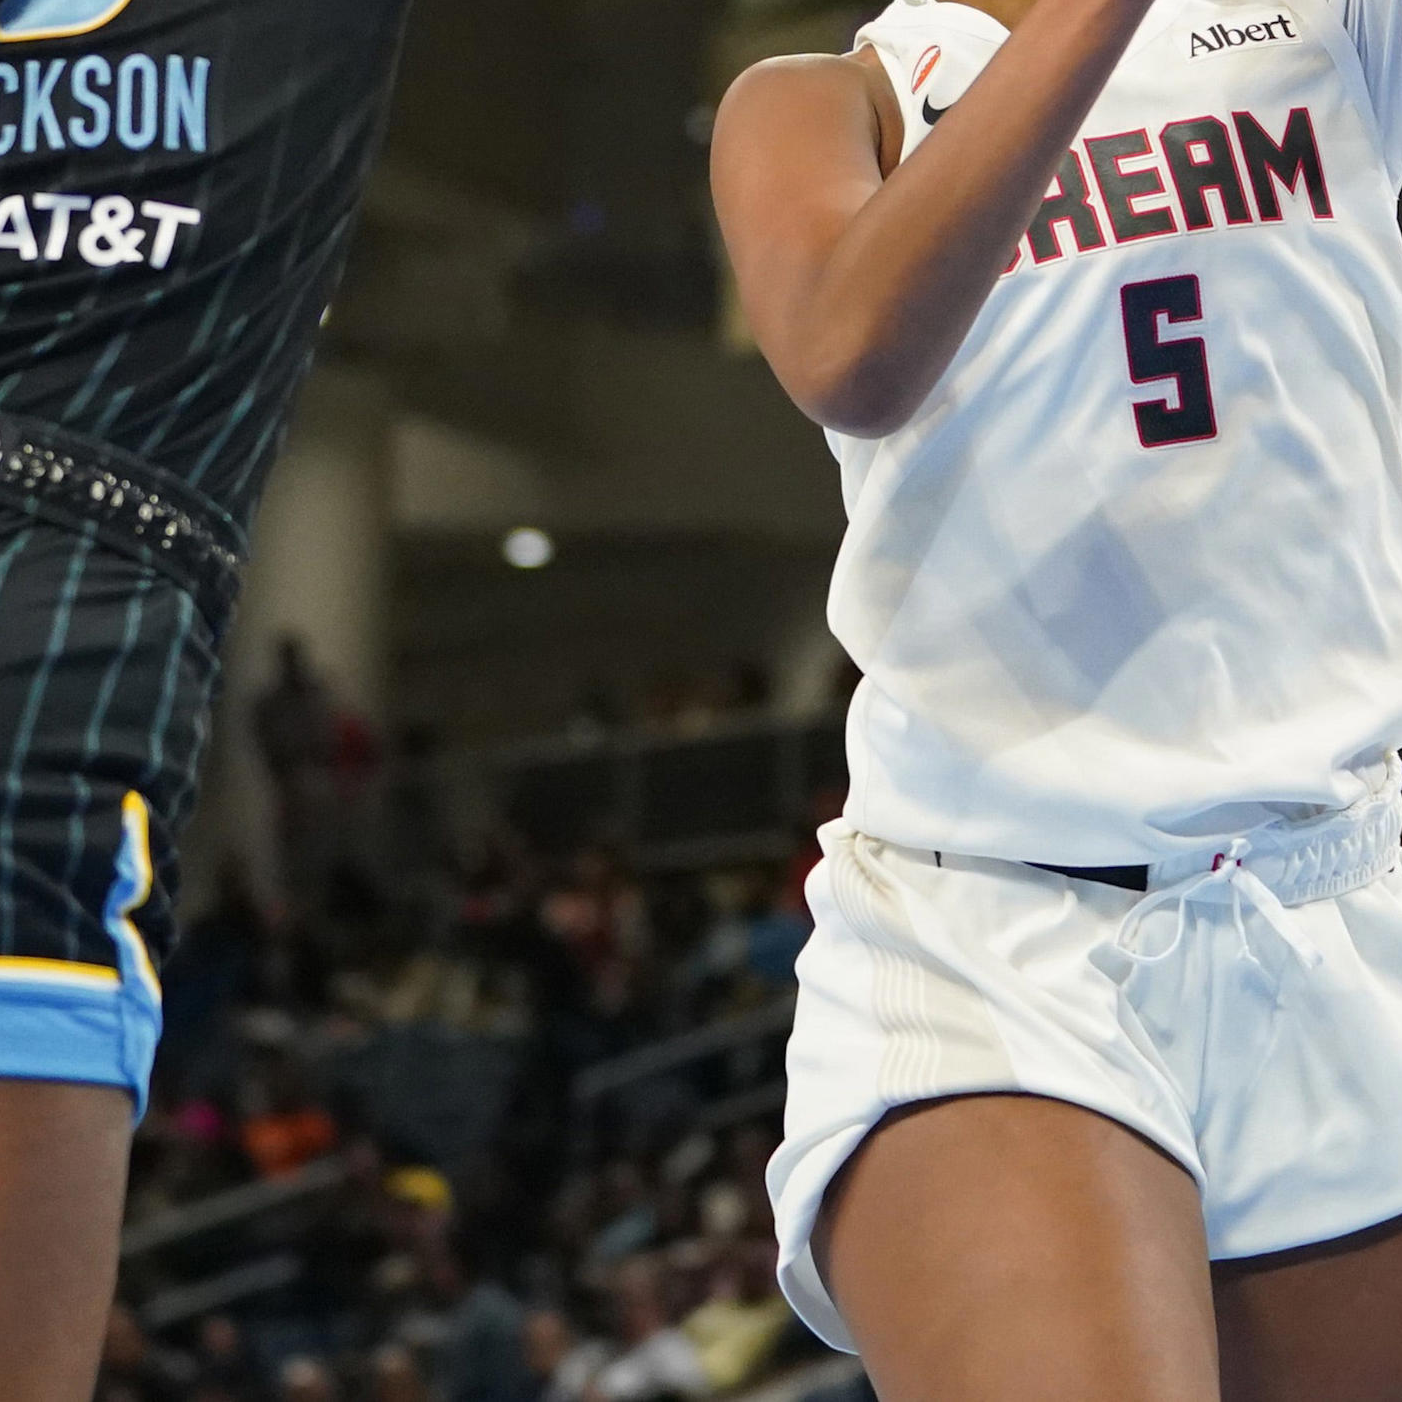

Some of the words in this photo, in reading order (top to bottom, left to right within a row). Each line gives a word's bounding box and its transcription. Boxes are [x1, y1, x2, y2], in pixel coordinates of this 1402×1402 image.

[1189, 14, 1297, 59] Albert
[999, 106, 1334, 278] REAM
[1119, 273, 1218, 448] 5
